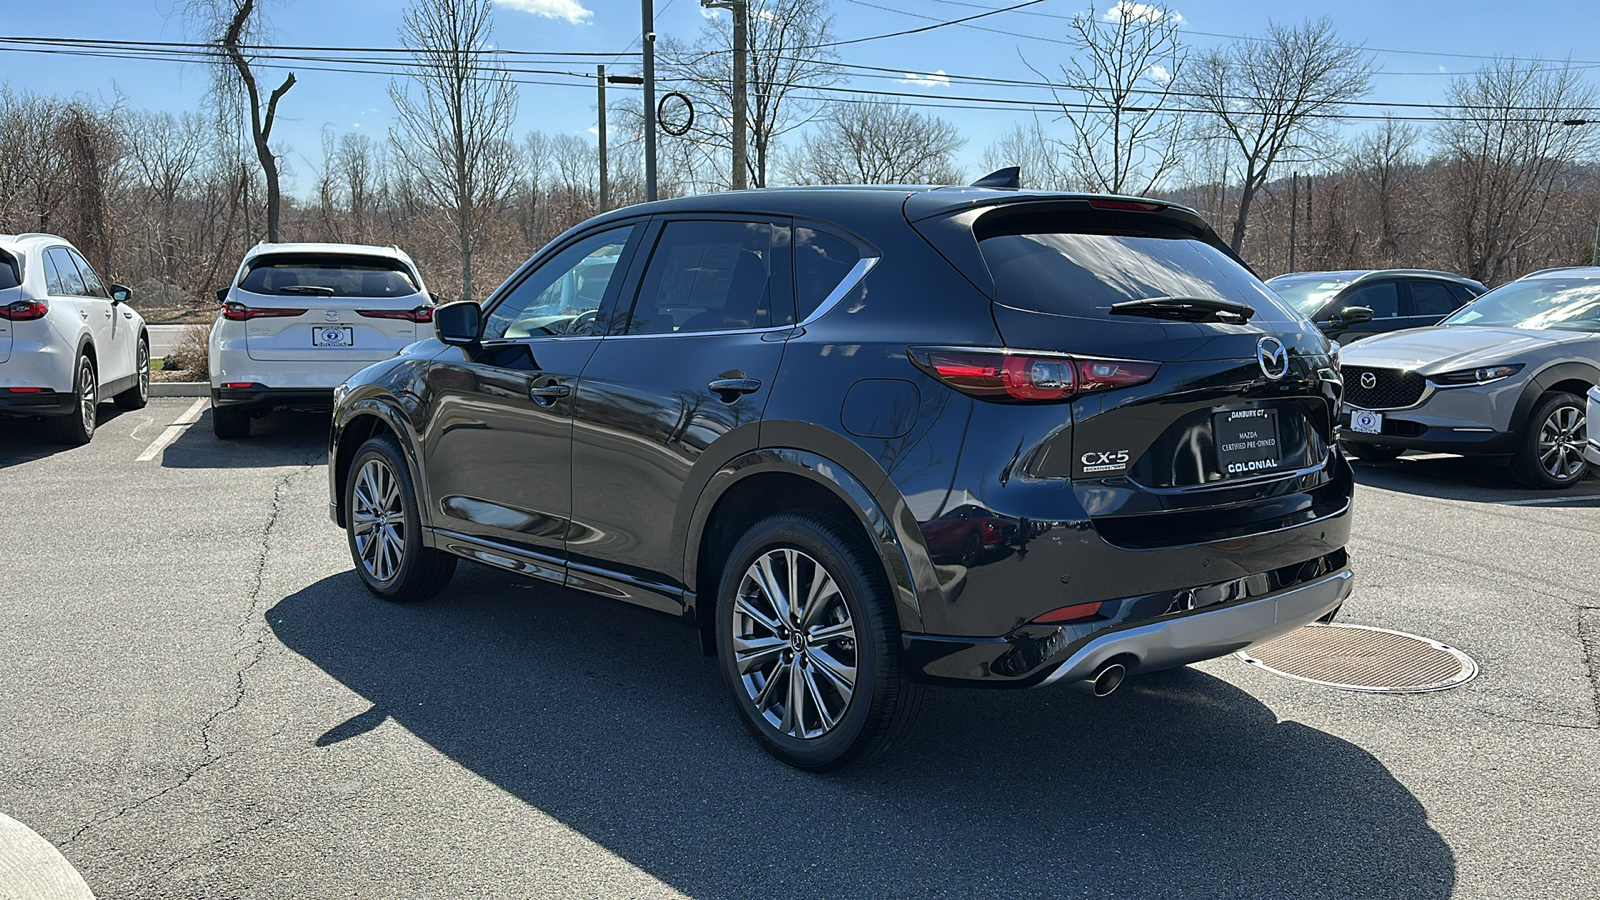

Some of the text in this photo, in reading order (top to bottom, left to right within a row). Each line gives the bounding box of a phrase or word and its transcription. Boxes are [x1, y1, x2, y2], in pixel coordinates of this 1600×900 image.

[1231, 409, 1265, 419] DANBURY CT
[1239, 431, 1258, 439] MAZDA
[1222, 438, 1276, 452] CERTIFIED PRE-OWNED
[1081, 449, 1129, 465] CX-5
[1228, 458, 1278, 473] COLONIAL
